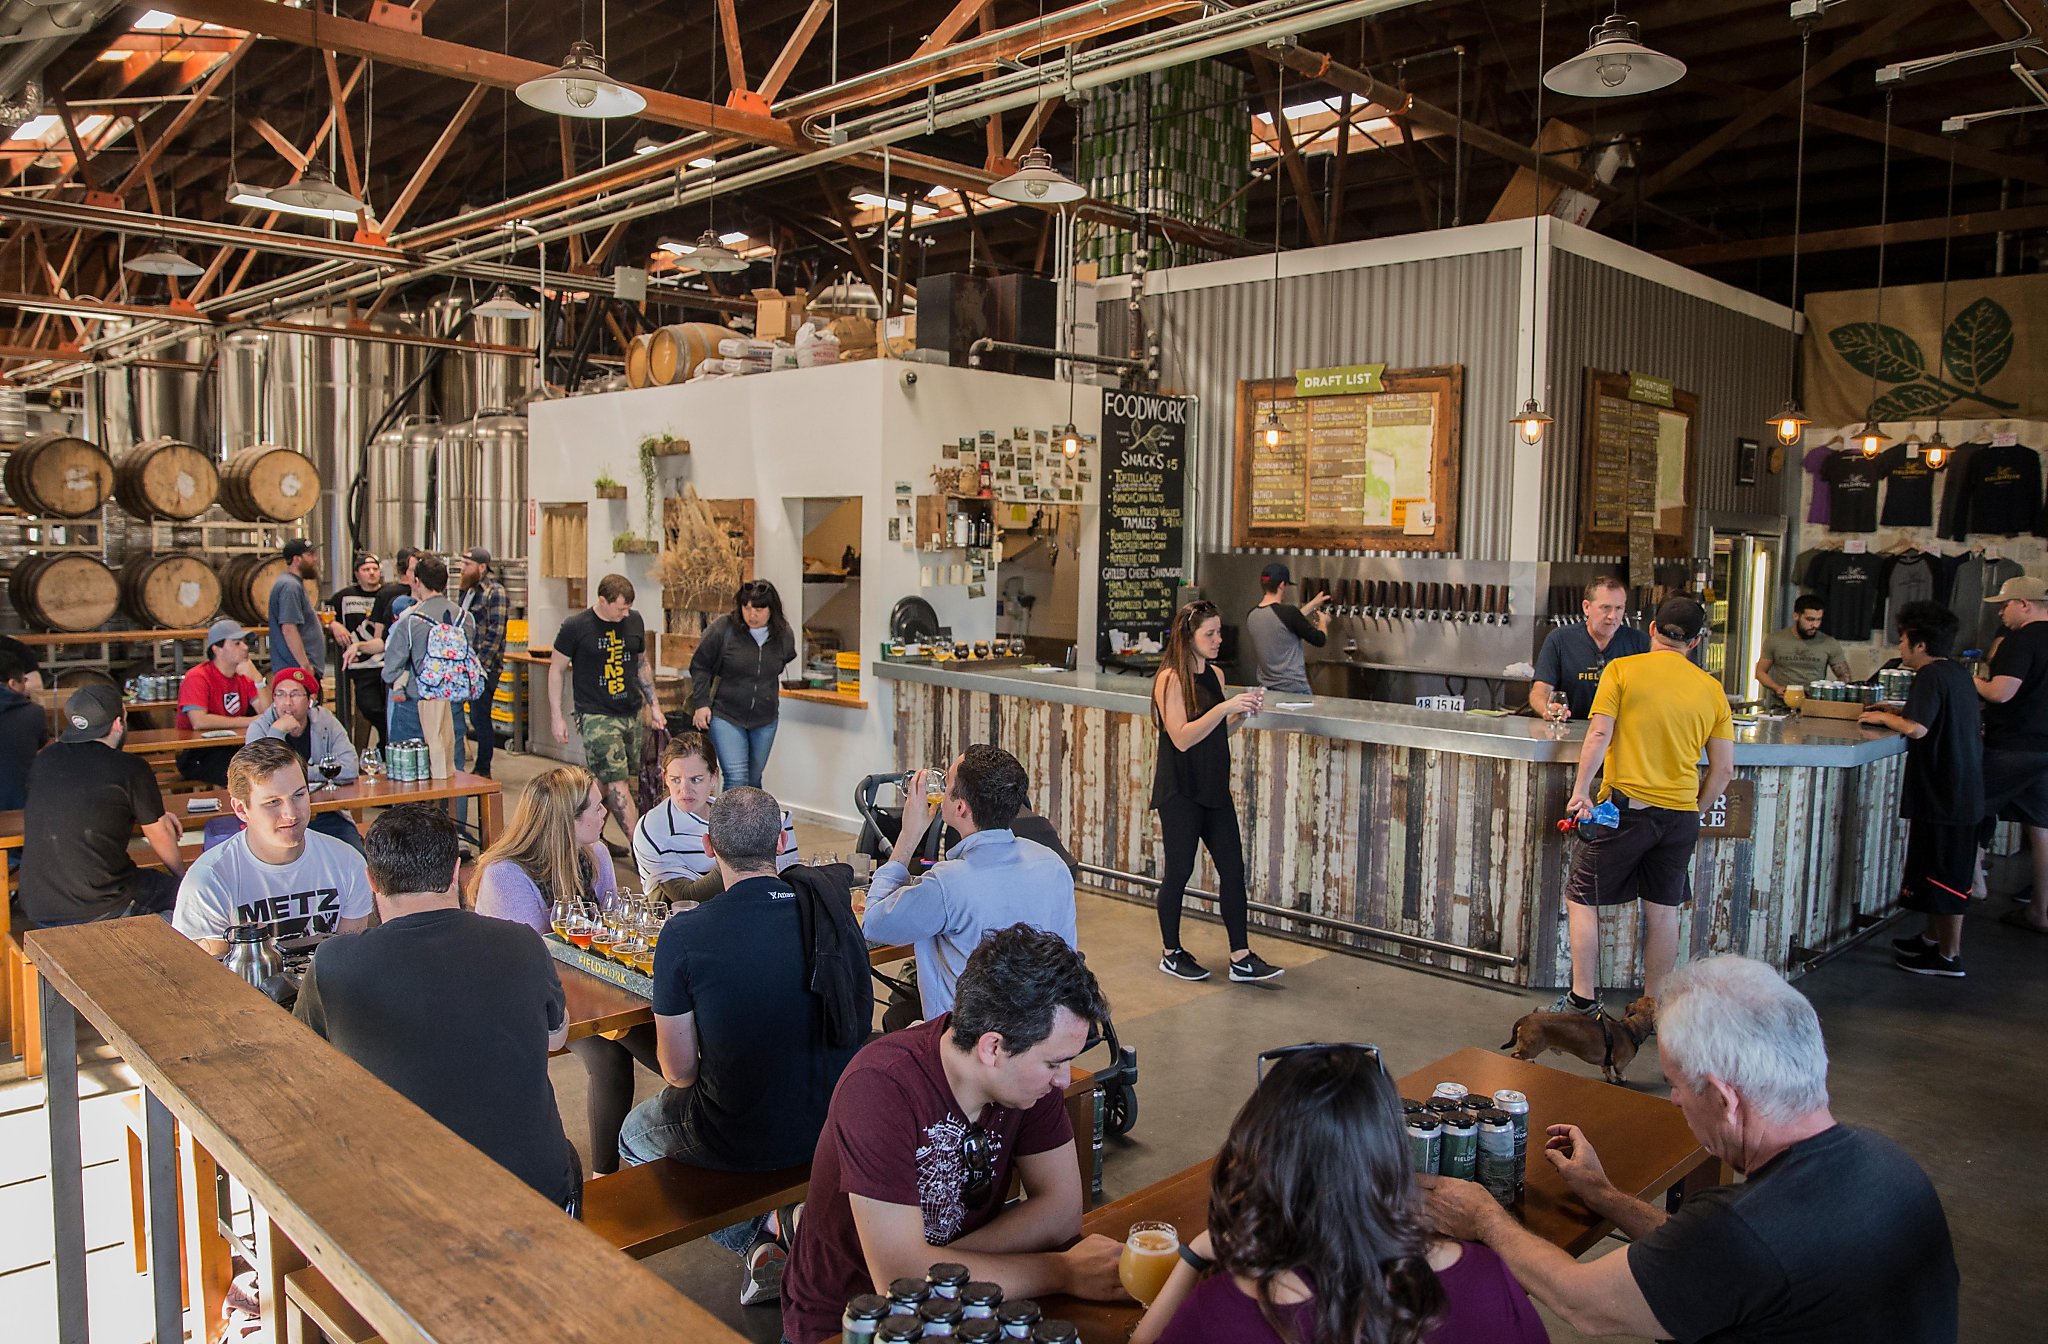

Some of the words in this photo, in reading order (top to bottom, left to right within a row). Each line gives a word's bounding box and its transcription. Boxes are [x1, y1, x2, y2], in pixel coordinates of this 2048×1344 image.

[1304, 374, 1342, 389] DRAFT
[1345, 372, 1373, 385] LIST
[1635, 378, 1669, 395] ADVENTURES
[1104, 392, 1186, 424] FOODWORK
[1121, 451, 1165, 470] SNACKS
[1121, 516, 1158, 530] TAMALES
[1102, 567, 1127, 580] GRILLED
[1128, 567, 1149, 580] CHEESE
[1578, 672, 1600, 681] FIEL
[1437, 699, 1447, 710] 15
[1450, 700, 1460, 711] 14
[237, 888, 341, 924] METZ
[577, 955, 627, 985] FIELDWORK
